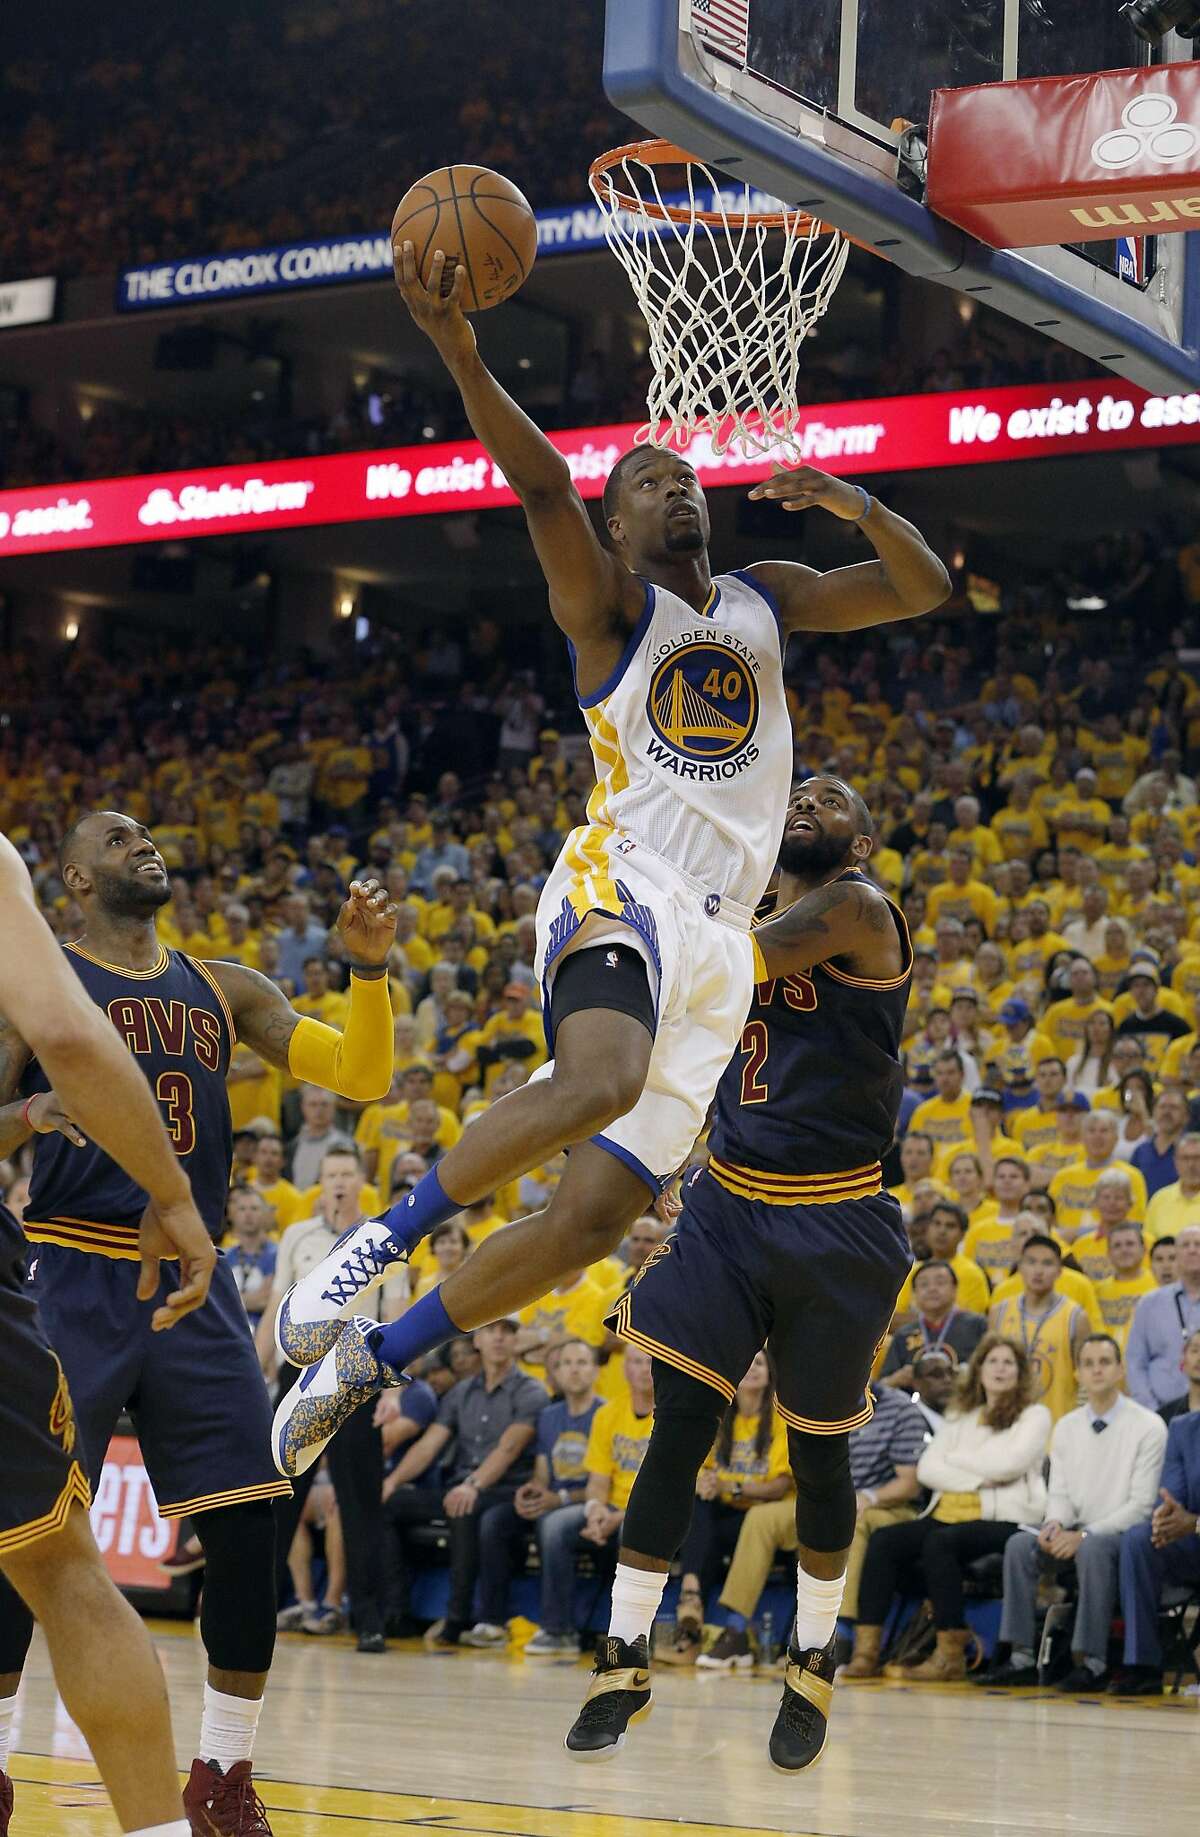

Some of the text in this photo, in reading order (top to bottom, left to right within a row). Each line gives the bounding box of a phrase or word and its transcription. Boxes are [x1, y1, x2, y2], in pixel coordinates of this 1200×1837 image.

[125, 266, 175, 300] THE
[174, 252, 279, 296] CLOROX
[279, 237, 393, 281] COMPAN
[1119, 254, 1135, 279] NBA
[948, 393, 1200, 445] We exist to ass
[366, 462, 412, 500] We
[414, 456, 488, 496] exist
[652, 630, 762, 675] GOLDEN STATE
[702, 668, 742, 701] 40
[645, 737, 760, 782] WARRIORS
[107, 997, 221, 1072] AVS
[739, 1020, 769, 1105] 2
[156, 1071, 196, 1156] 3
[385, 1241, 399, 1254] 40
